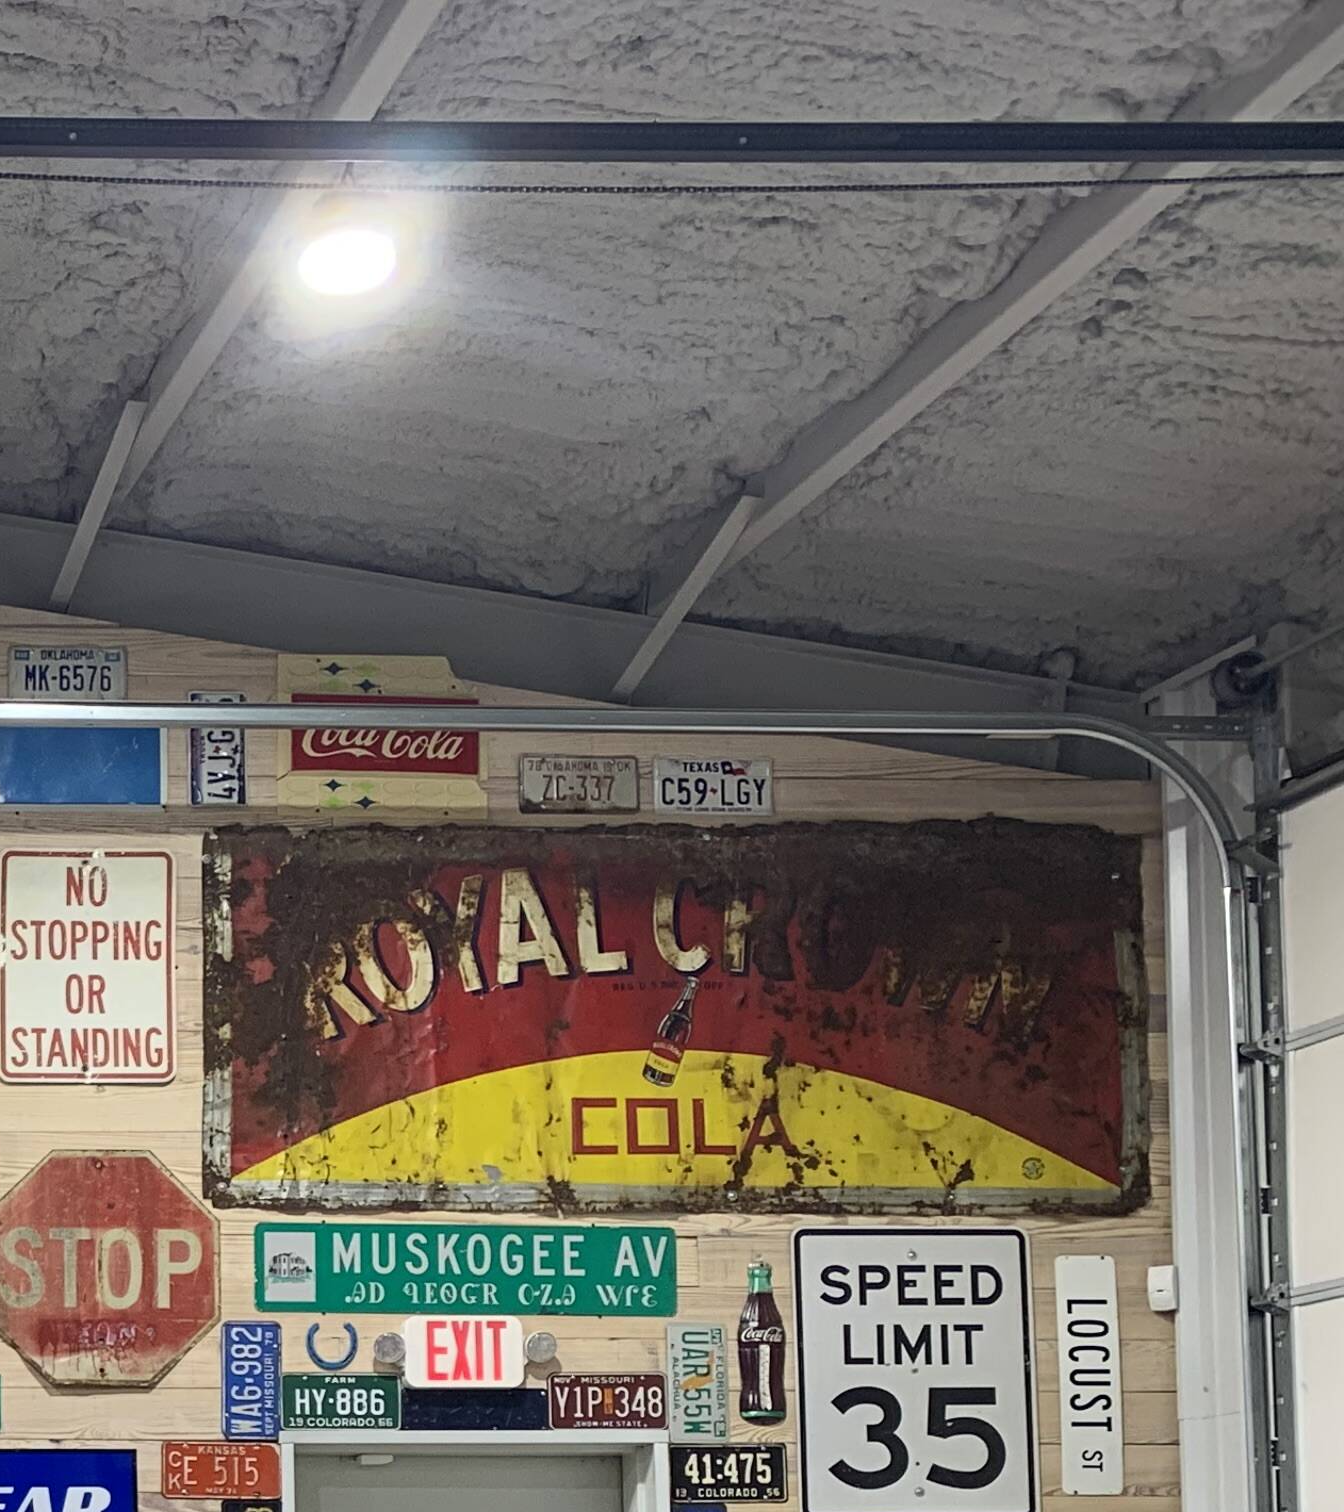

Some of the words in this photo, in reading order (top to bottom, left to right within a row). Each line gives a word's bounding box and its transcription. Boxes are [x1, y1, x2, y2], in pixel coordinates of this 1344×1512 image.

[40, 650, 95, 661] OKLAHOMA
[683, 762, 720, 773] TEXAS
[65, 866, 109, 908] NO
[10, 920, 162, 962] STOPPING
[65, 974, 107, 1016] OR
[10, 1027, 164, 1068] STANDING
[570, 1096, 800, 1157] COLA
[332, 1232, 586, 1278] MUSKOGEE
[614, 1235, 668, 1278] AV
[820, 1265, 1003, 1306] SPEED
[426, 1320, 507, 1381] EXIT
[842, 1324, 984, 1365] LIMIT
[324, 1376, 356, 1384] FARM
[581, 1376, 635, 1384] MISSOURI
[1066, 1299, 1112, 1432] LOCUST
[306, 1418, 375, 1428] COLORADO
[828, 1387, 1006, 1490] 35
[198, 1446, 246, 1456] KANSAS
[1080, 1449, 1103, 1472] ST
[698, 1488, 757, 1498] COLORADO
